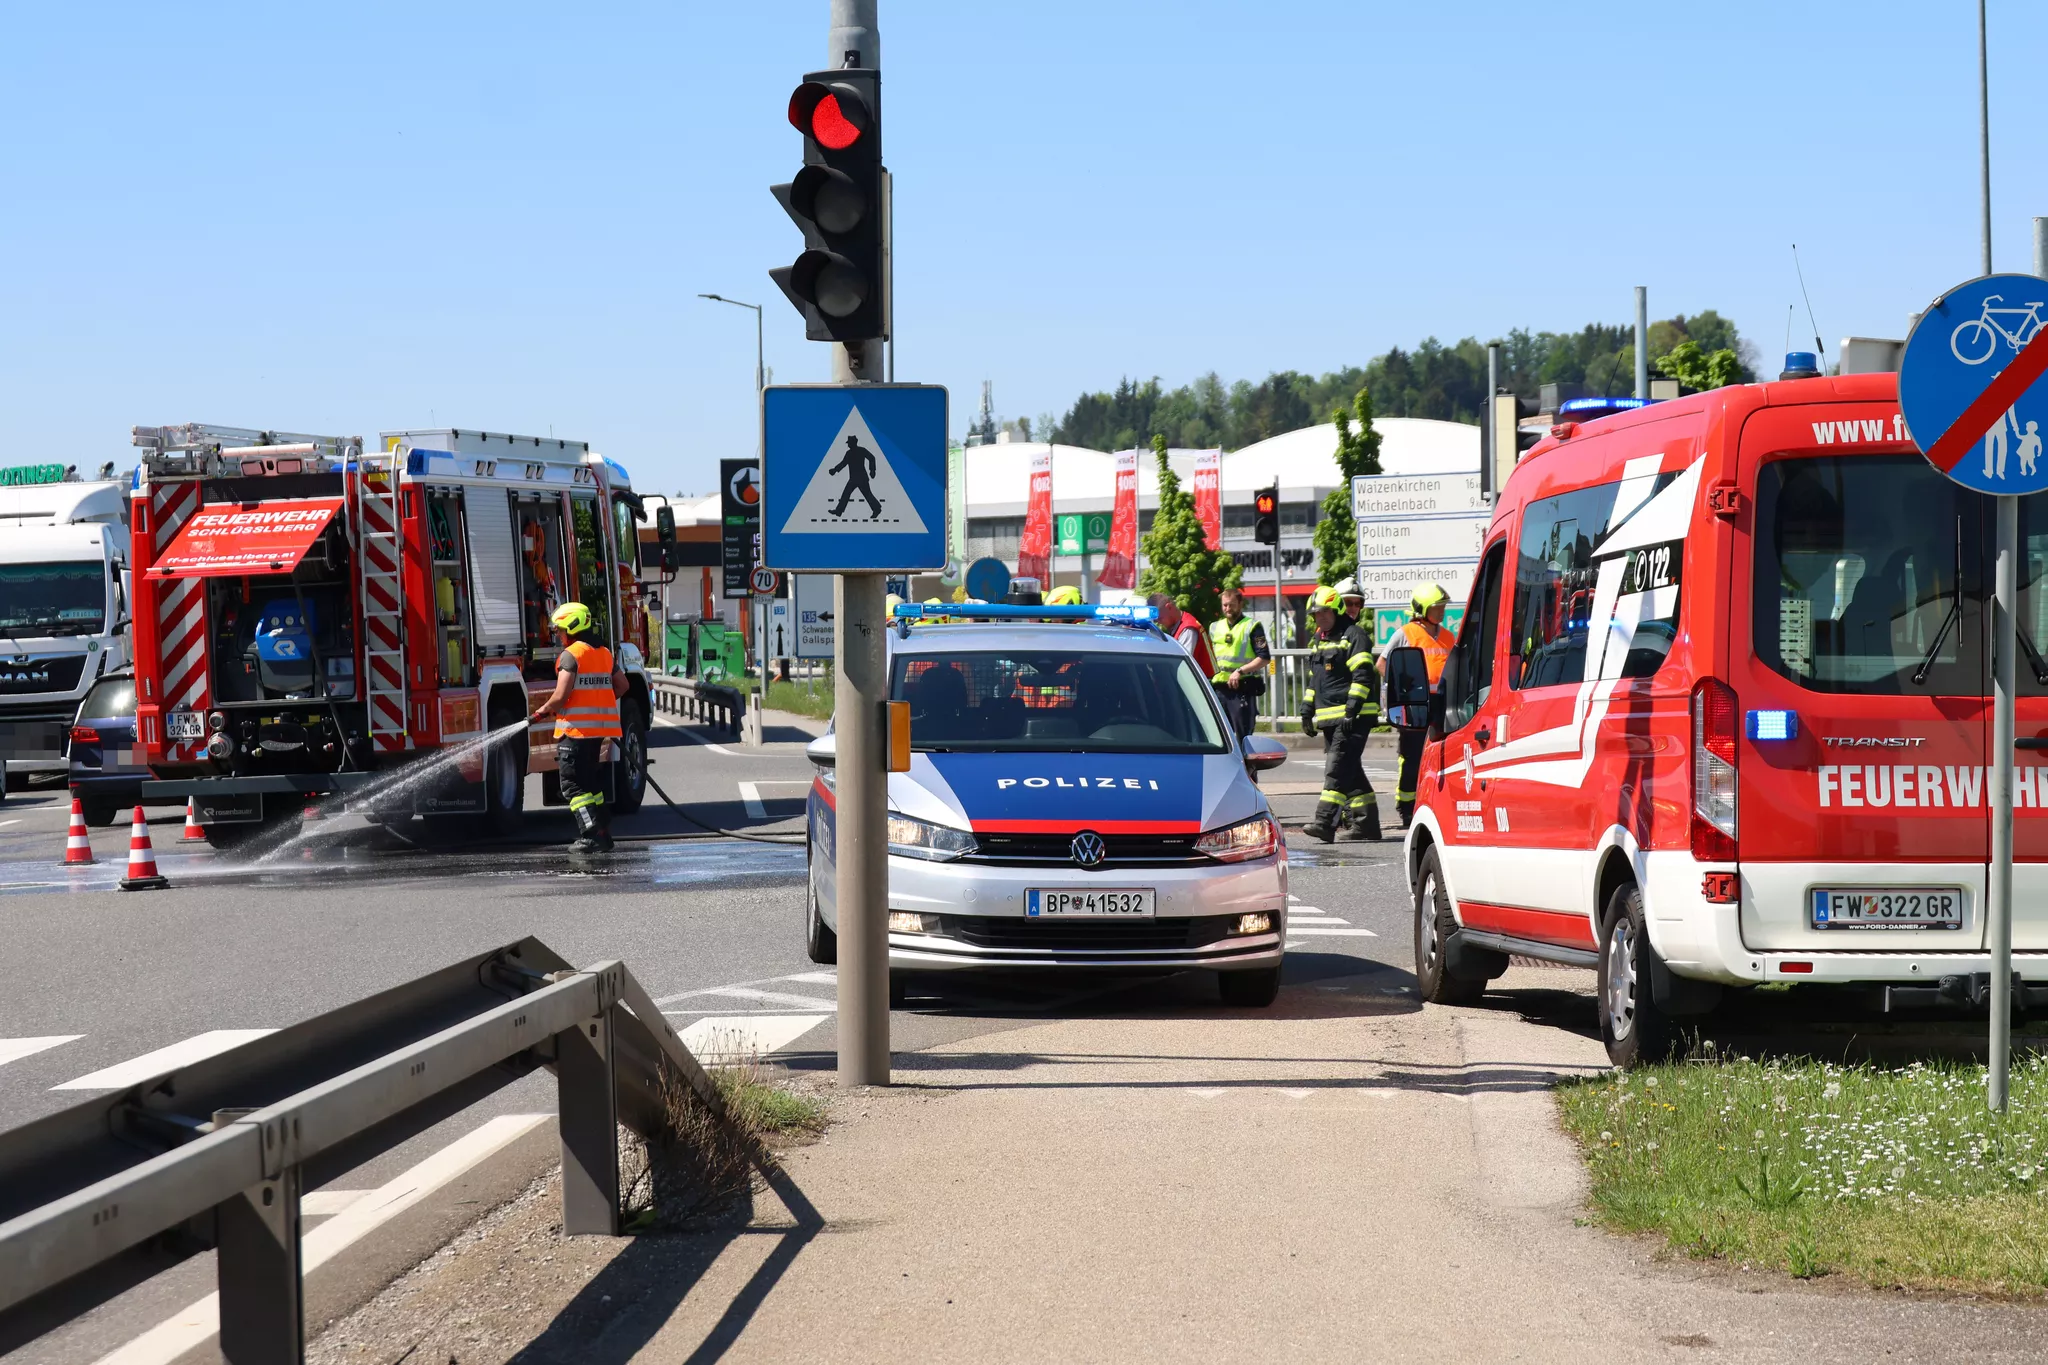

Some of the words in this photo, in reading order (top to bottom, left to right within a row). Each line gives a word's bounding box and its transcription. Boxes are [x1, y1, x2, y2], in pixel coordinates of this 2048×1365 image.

[1357, 479, 1441, 494] Waizenkirchen
[1466, 478, 1475, 489] 16
[1357, 498, 1436, 512] Michaelnbach
[1470, 497, 1475, 507] 9
[190, 509, 332, 527] FEUERWEHR
[187, 523, 317, 537] SCHLÜSSLBERG
[1362, 525, 1411, 538] Pollham
[1475, 523, 1480, 534] 5
[1362, 543, 1397, 556] Tollet
[1475, 541, 1480, 552] 5
[1648, 546, 1671, 588] 122
[757, 572, 771, 587] 70
[1362, 568, 1458, 582] Prambachkirchen
[1363, 588, 1378, 600] St.
[1381, 587, 1412, 600] Thom
[803, 612, 816, 622] 135
[803, 636, 834, 645] Gallspa
[0, 671, 49, 682] MAN
[178, 715, 190, 724] FW
[171, 726, 187, 735] 324
[190, 725, 201, 735] GR
[1822, 737, 1926, 747] TRANSIT
[997, 777, 1159, 790] POLIZEI
[1818, 765, 2048, 808] FEUERWH
[215, 808, 252, 816] rosenbauer
[1046, 894, 1069, 912] BP
[1086, 894, 1143, 912] 41532
[1832, 896, 1862, 917] FW
[1881, 896, 1921, 917] 322
[1927, 896, 1953, 917] GR
